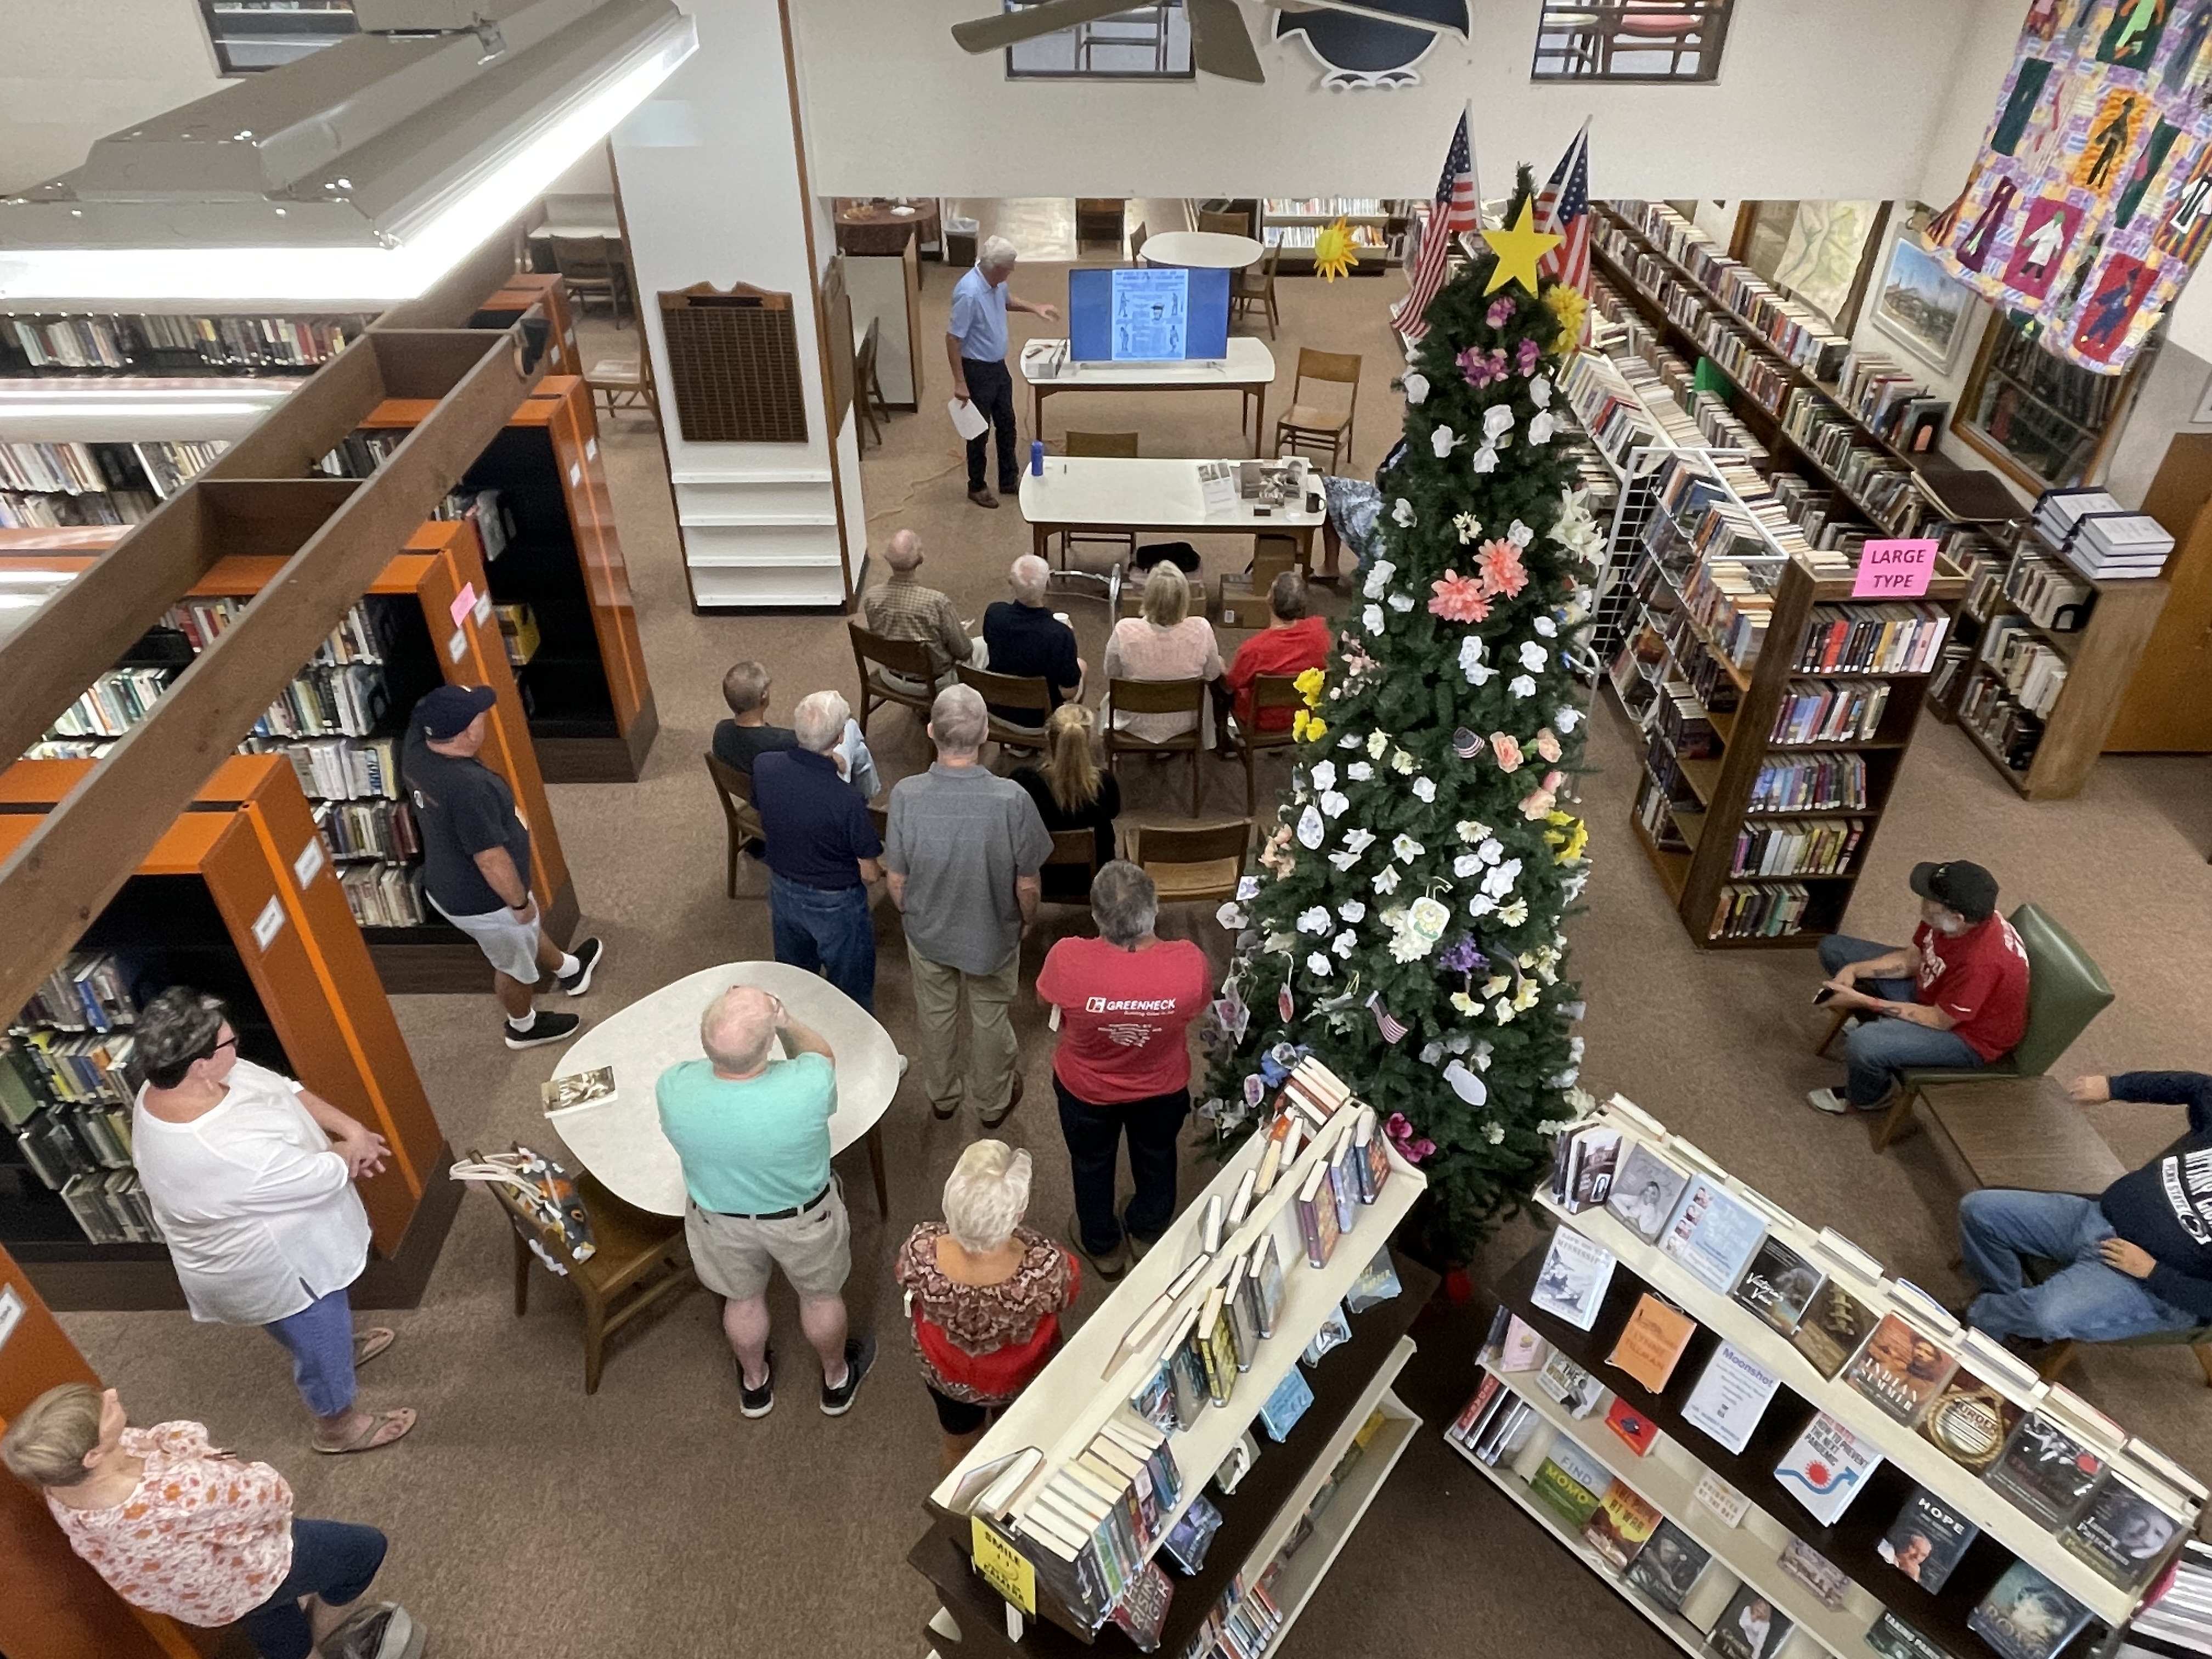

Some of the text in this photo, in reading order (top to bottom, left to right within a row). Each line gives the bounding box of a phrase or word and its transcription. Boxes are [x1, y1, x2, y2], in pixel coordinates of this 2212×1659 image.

[1871, 549, 1926, 564] LARGE
[1873, 574, 1914, 588] TYPE
[1107, 998, 1176, 1011] GREENHECK
[1723, 1347, 1774, 1389] Moonshot
[1545, 1466, 1589, 1504] MOMO
[1560, 1457, 1592, 1485] FIND
[1918, 1498, 1965, 1535] HOPE
[985, 1531, 1020, 1567] SMILE
[1132, 1565, 1159, 1629] RISING
[1143, 1579, 1169, 1635] TIGER
